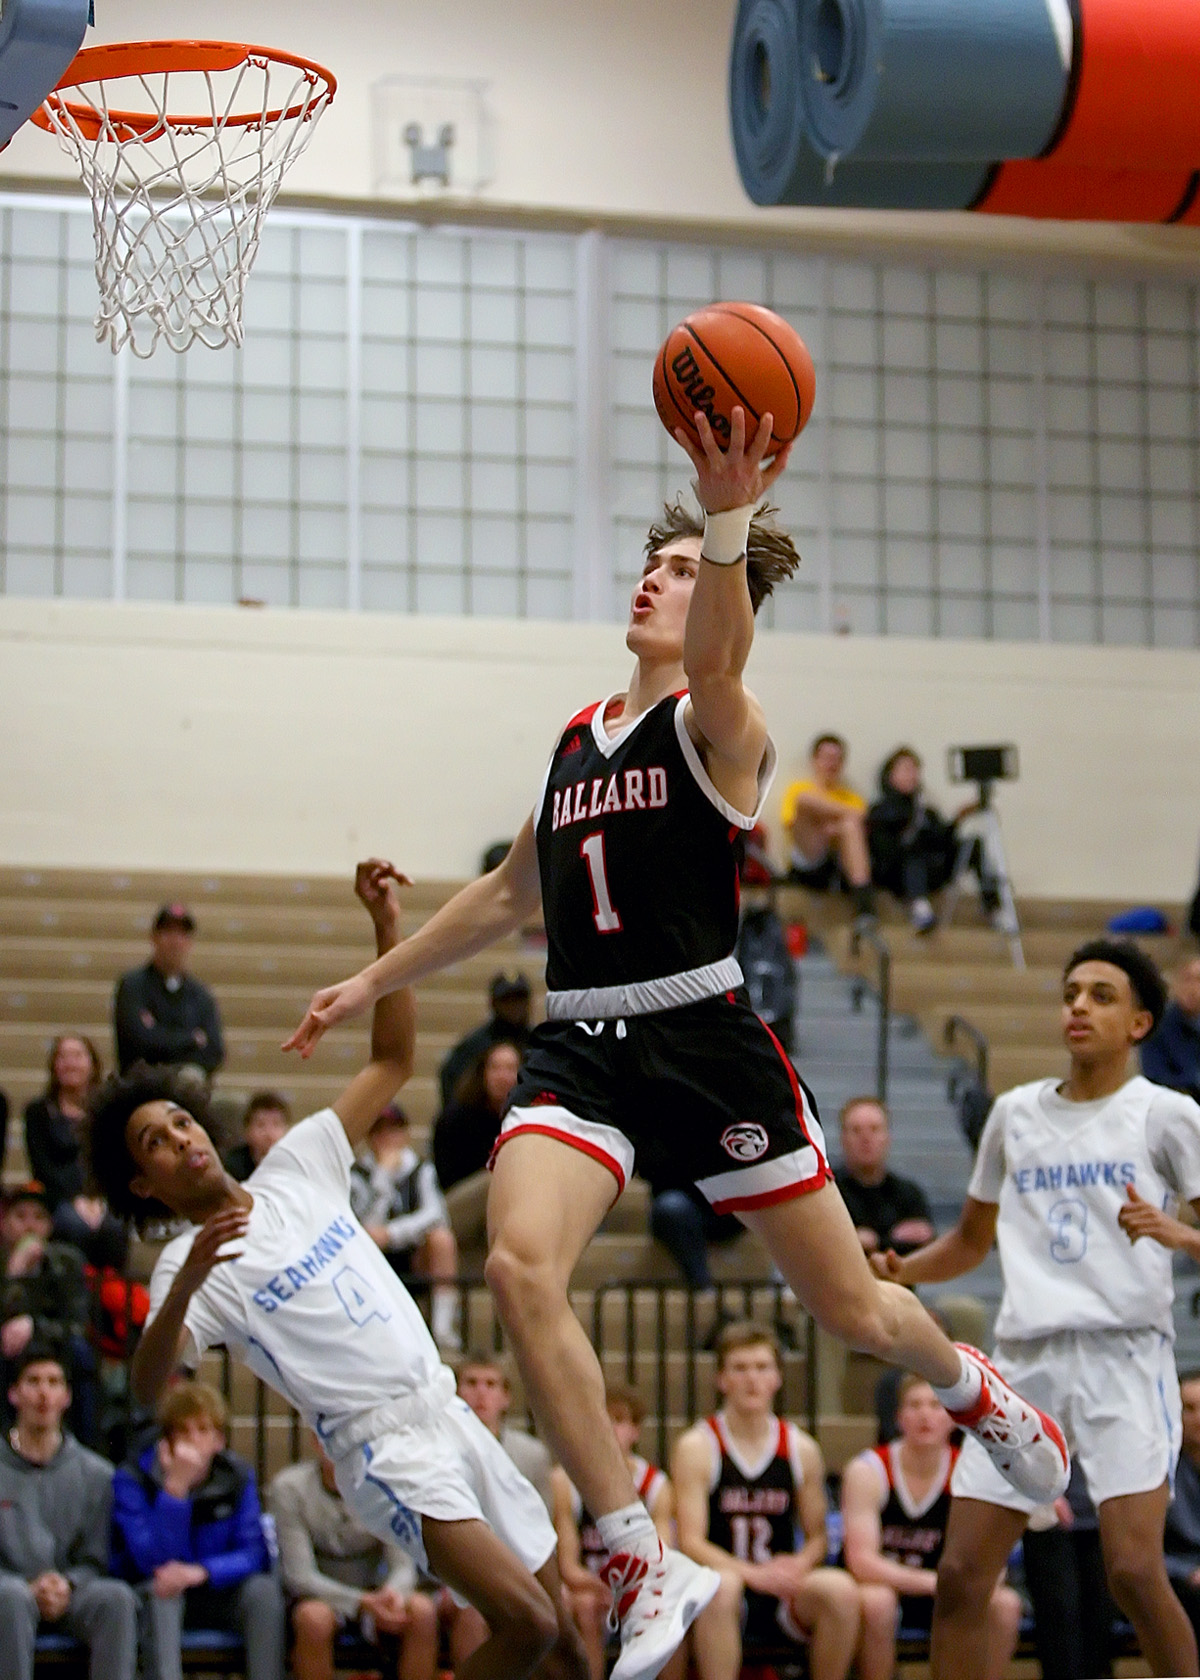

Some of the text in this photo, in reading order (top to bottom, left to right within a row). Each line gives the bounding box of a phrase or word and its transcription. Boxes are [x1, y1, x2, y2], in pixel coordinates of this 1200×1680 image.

[672, 346, 731, 438] Wilso
[552, 766, 668, 832] BALLARD
[580, 830, 624, 935] 1
[1048, 1199, 1088, 1264] 3
[331, 1265, 392, 1328] 4
